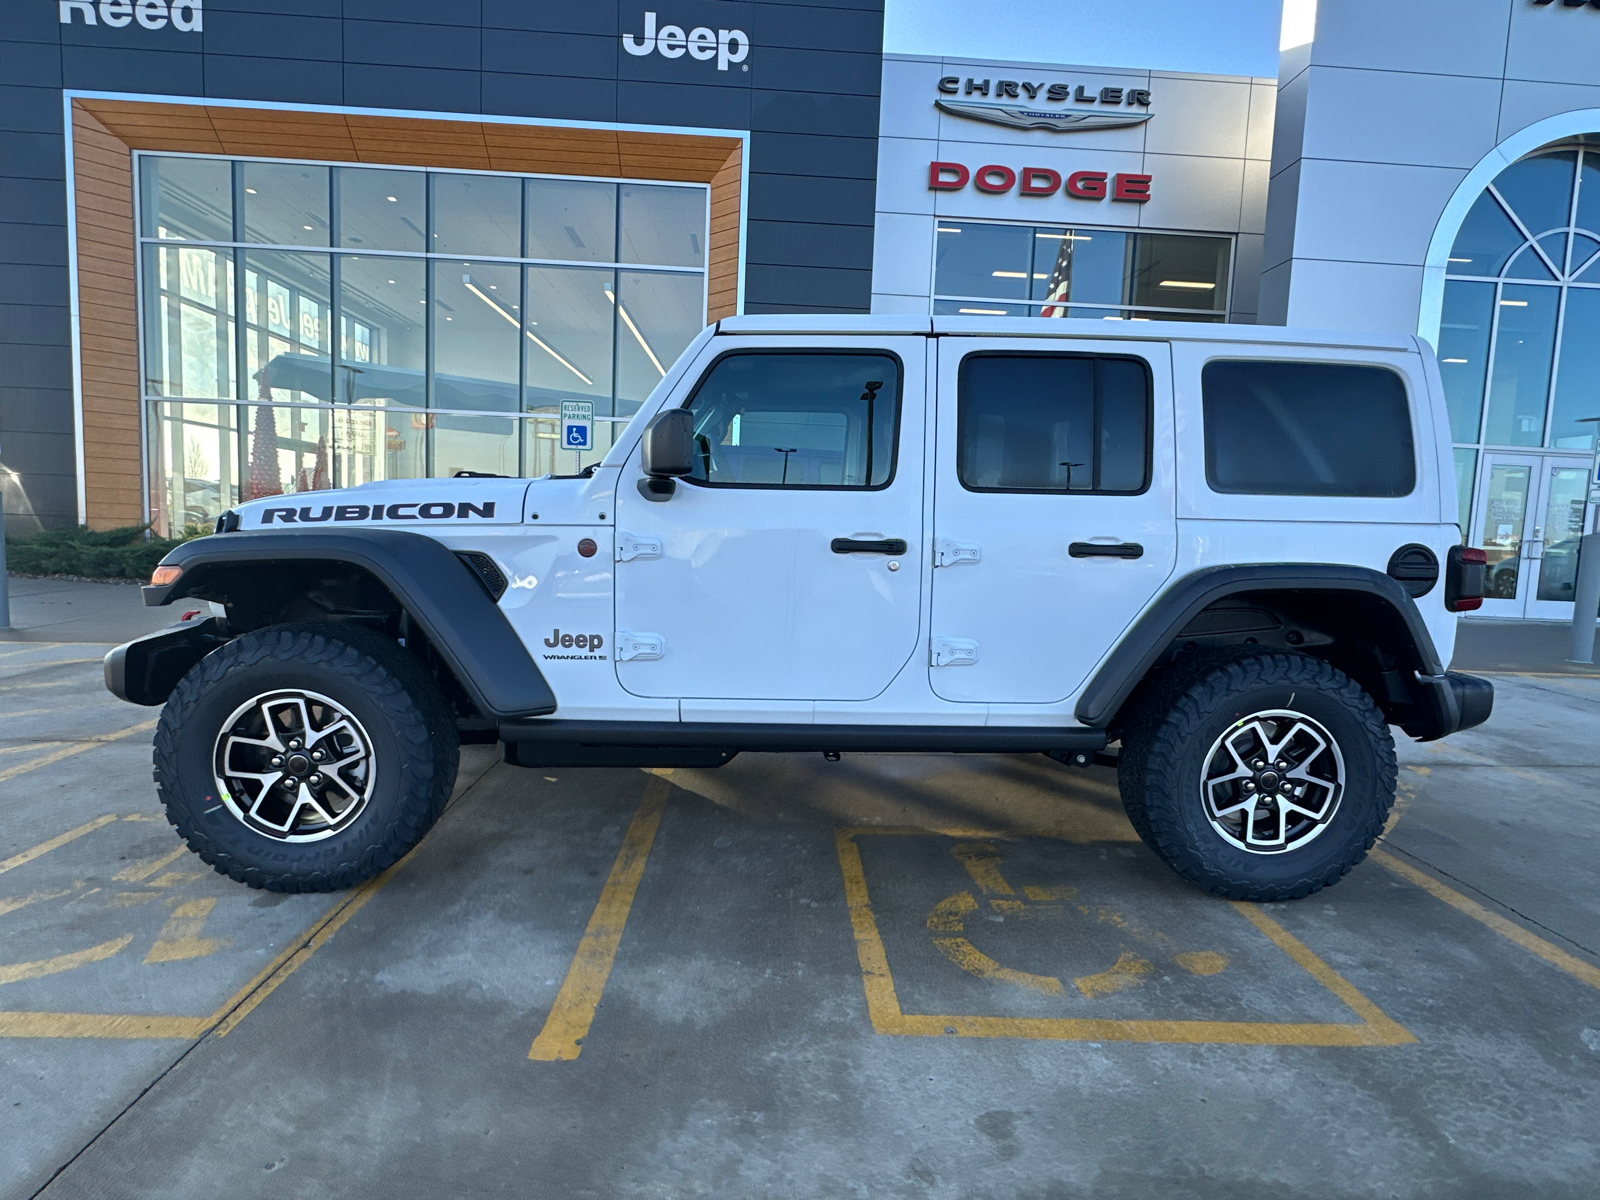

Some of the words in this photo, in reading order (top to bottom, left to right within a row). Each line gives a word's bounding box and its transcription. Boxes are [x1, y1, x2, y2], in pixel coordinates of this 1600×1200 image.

[622, 11, 750, 71] Jeep
[937, 76, 1152, 106] CHRYSLER
[928, 161, 1153, 203] DODGE
[563, 404, 591, 413] RESERVED
[563, 413, 591, 421] PARKING
[261, 501, 496, 524] RUBICON
[543, 628, 604, 652] Jeep
